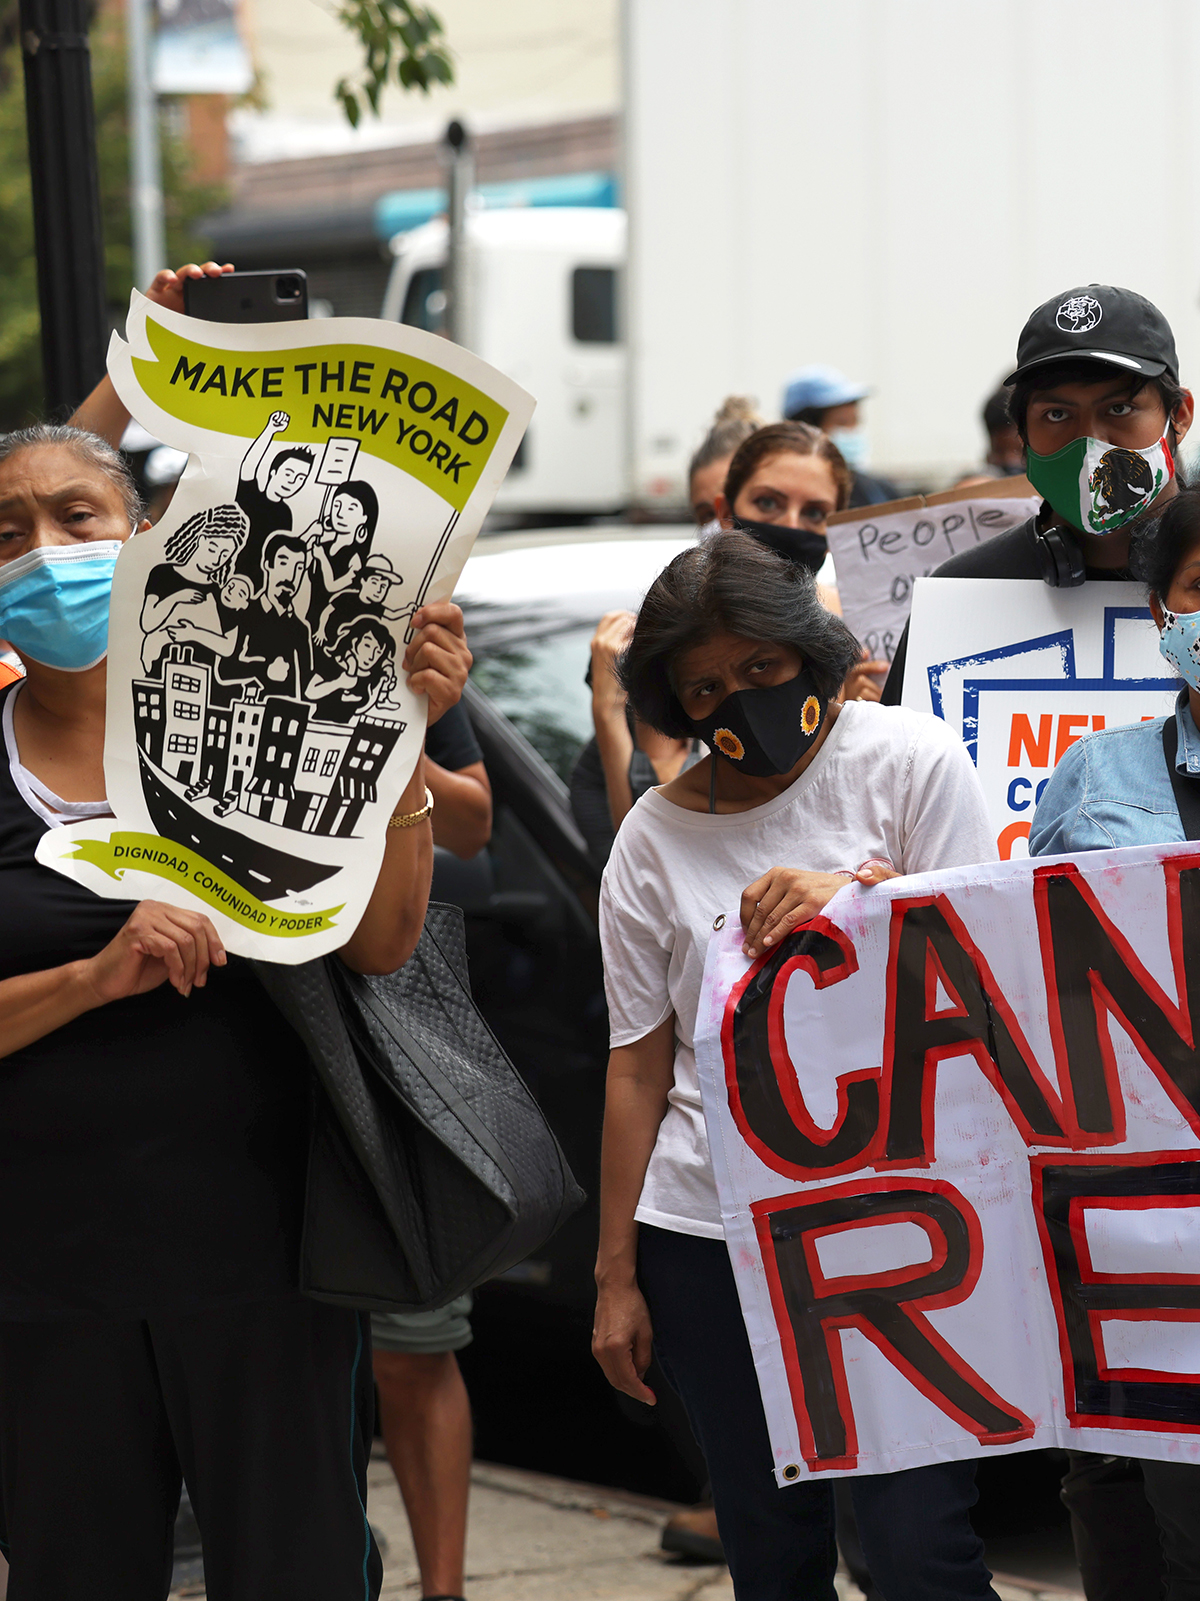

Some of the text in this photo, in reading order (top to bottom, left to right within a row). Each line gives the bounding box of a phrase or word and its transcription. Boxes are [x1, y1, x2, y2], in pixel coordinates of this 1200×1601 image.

[169, 355, 489, 447] MAKE THE ROAD
[312, 403, 471, 484] NEW YORK
[1007, 713, 1155, 768] NE
[114, 846, 323, 930] DIGNIDAD, COMUNIDAD Y PODER
